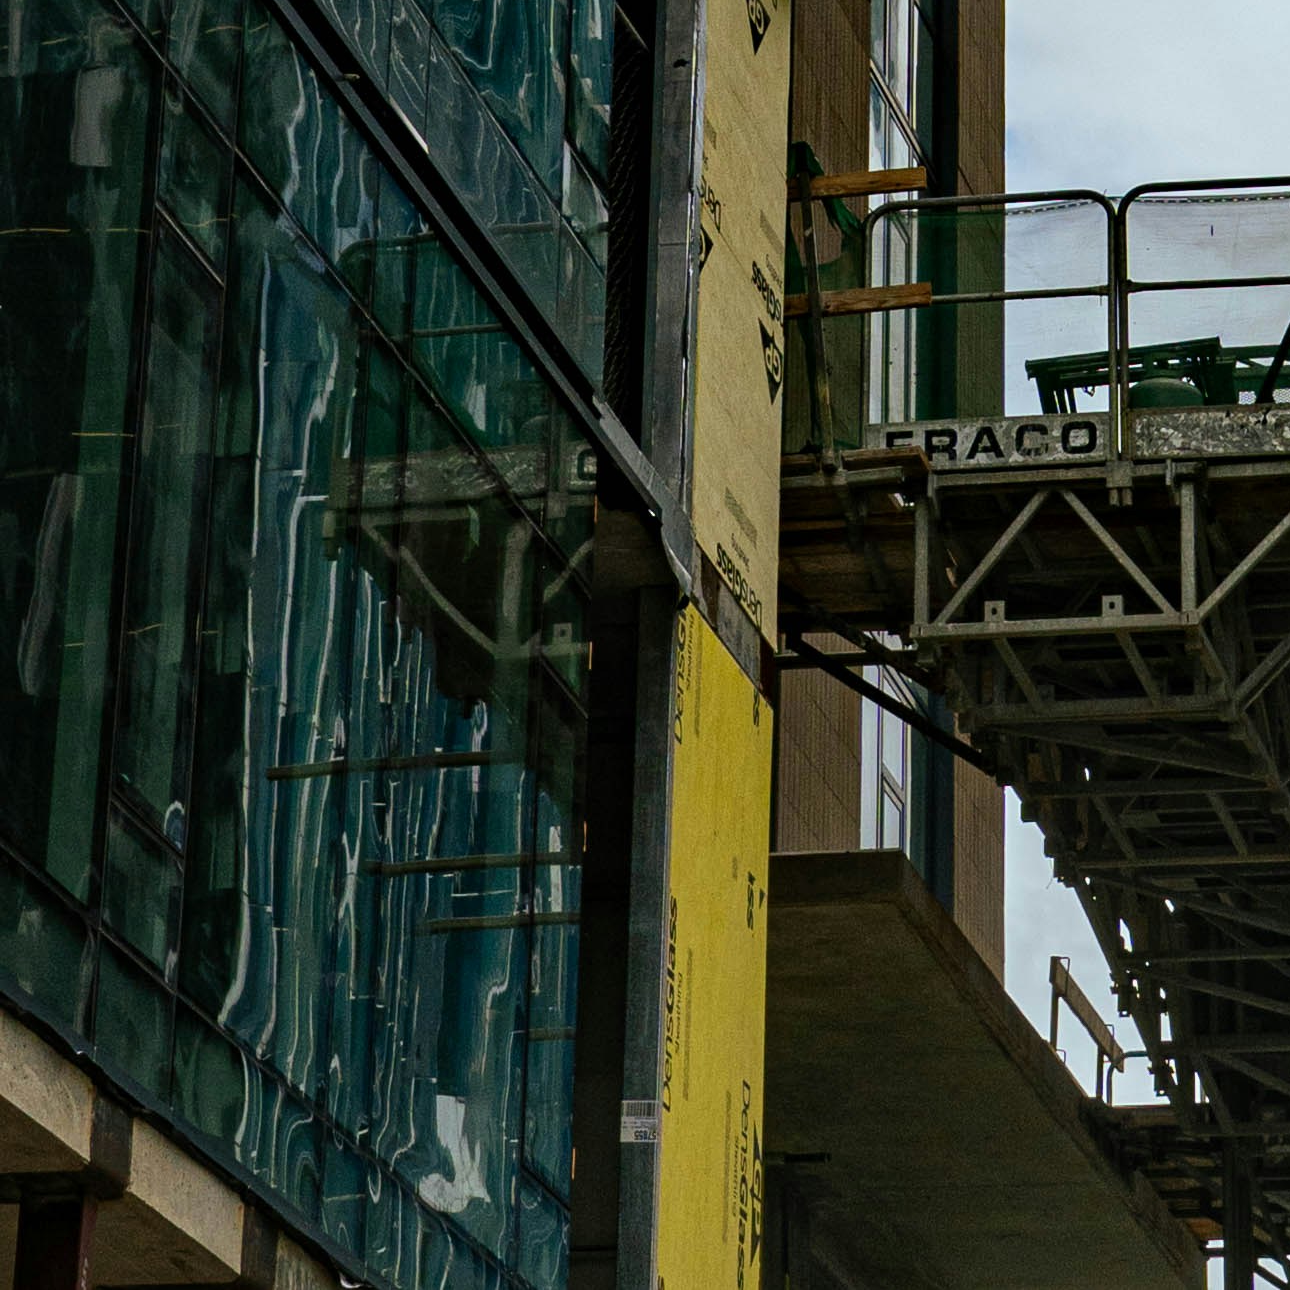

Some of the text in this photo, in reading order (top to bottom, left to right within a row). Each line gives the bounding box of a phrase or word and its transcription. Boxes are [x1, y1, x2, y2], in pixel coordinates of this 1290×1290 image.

[752, 260, 783, 326] sGlass
[886, 421, 1098, 462] FRACO
[662, 895, 678, 1113] DensGlass
